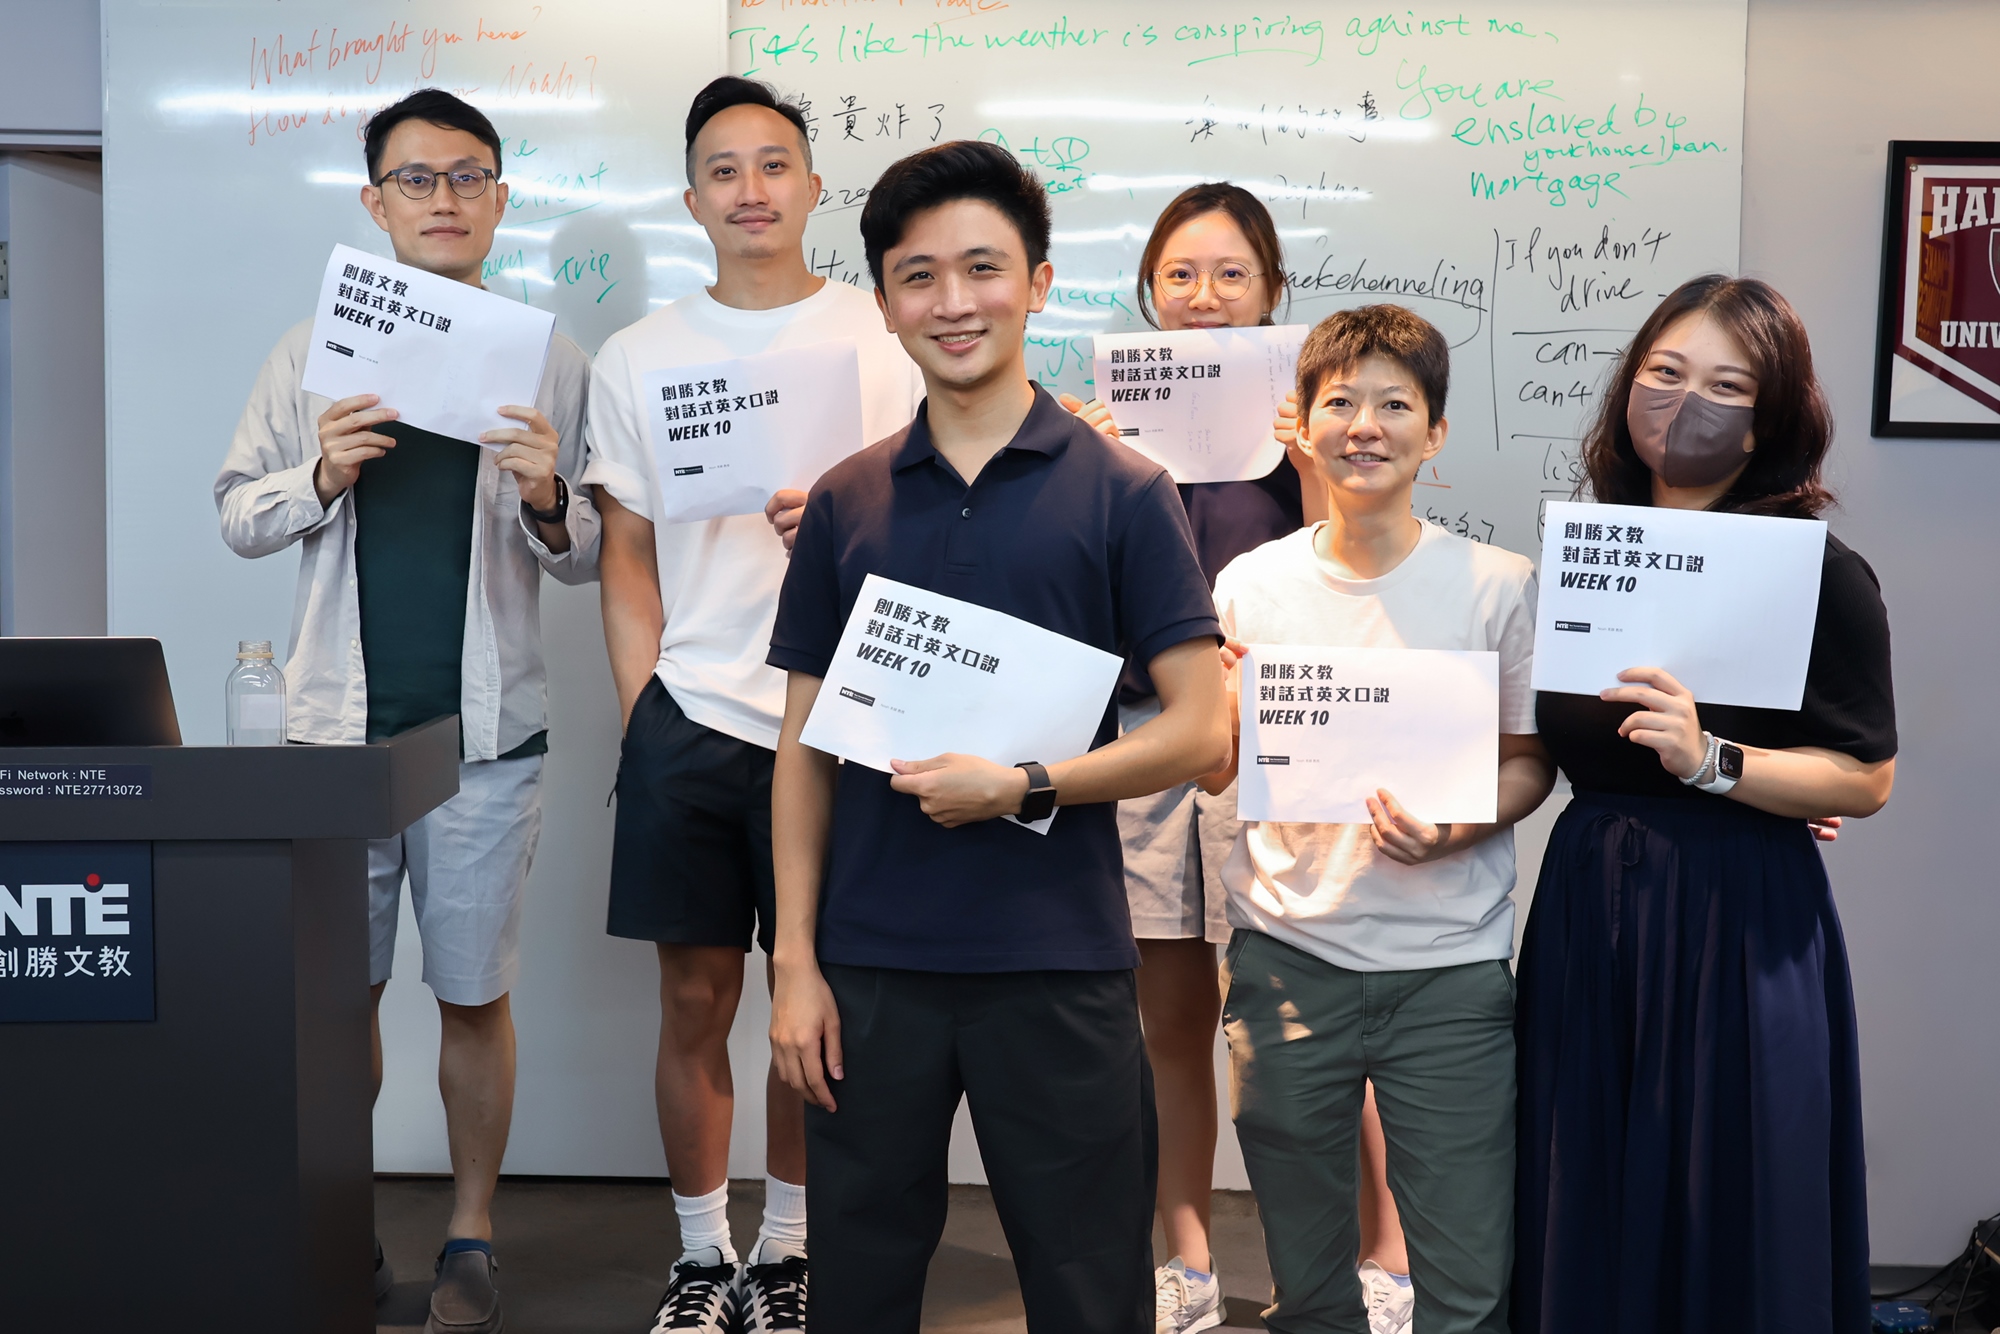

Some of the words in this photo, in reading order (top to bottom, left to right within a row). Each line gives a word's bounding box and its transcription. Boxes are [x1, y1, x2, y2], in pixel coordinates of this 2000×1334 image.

[838, 22, 908, 63] like
[912, 22, 975, 58] the
[984, 16, 1109, 50] weather
[1122, 24, 1158, 47] is
[1345, 11, 1470, 56] against
[328, 20, 415, 85] brought
[1494, 79, 1565, 102] are
[1451, 102, 1622, 146] enslaved
[1505, 226, 1542, 273] If
[1547, 243, 1584, 291] you
[1594, 224, 1672, 265] don't
[342, 263, 409, 298] 創勝文教
[1560, 271, 1644, 313] drive
[333, 302, 376, 329] WEEK
[377, 319, 395, 335] 10
[1111, 347, 1173, 364] 創勝文教
[1535, 341, 1588, 366] can
[661, 377, 728, 402] 創勝文教
[1111, 387, 1152, 403] WEEK
[1154, 386, 1171, 401] 10
[668, 422, 710, 442] WEEK
[713, 419, 732, 436] 10
[1564, 522, 1645, 544] 創勝文教
[1560, 571, 1612, 591] WEEK
[1615, 575, 1637, 593] 10
[873, 597, 951, 634] 創勝文教
[856, 642, 909, 672] WEEK
[909, 660, 931, 678] 10
[1260, 663, 1333, 680] 創勝文教
[1259, 709, 1306, 725] WEEK
[1310, 710, 1330, 726] 10
[17, 769, 69, 780] Network
[79, 769, 107, 780] NTE
[55, 785, 143, 796] NTE27713072
[0, 883, 130, 936] NTE
